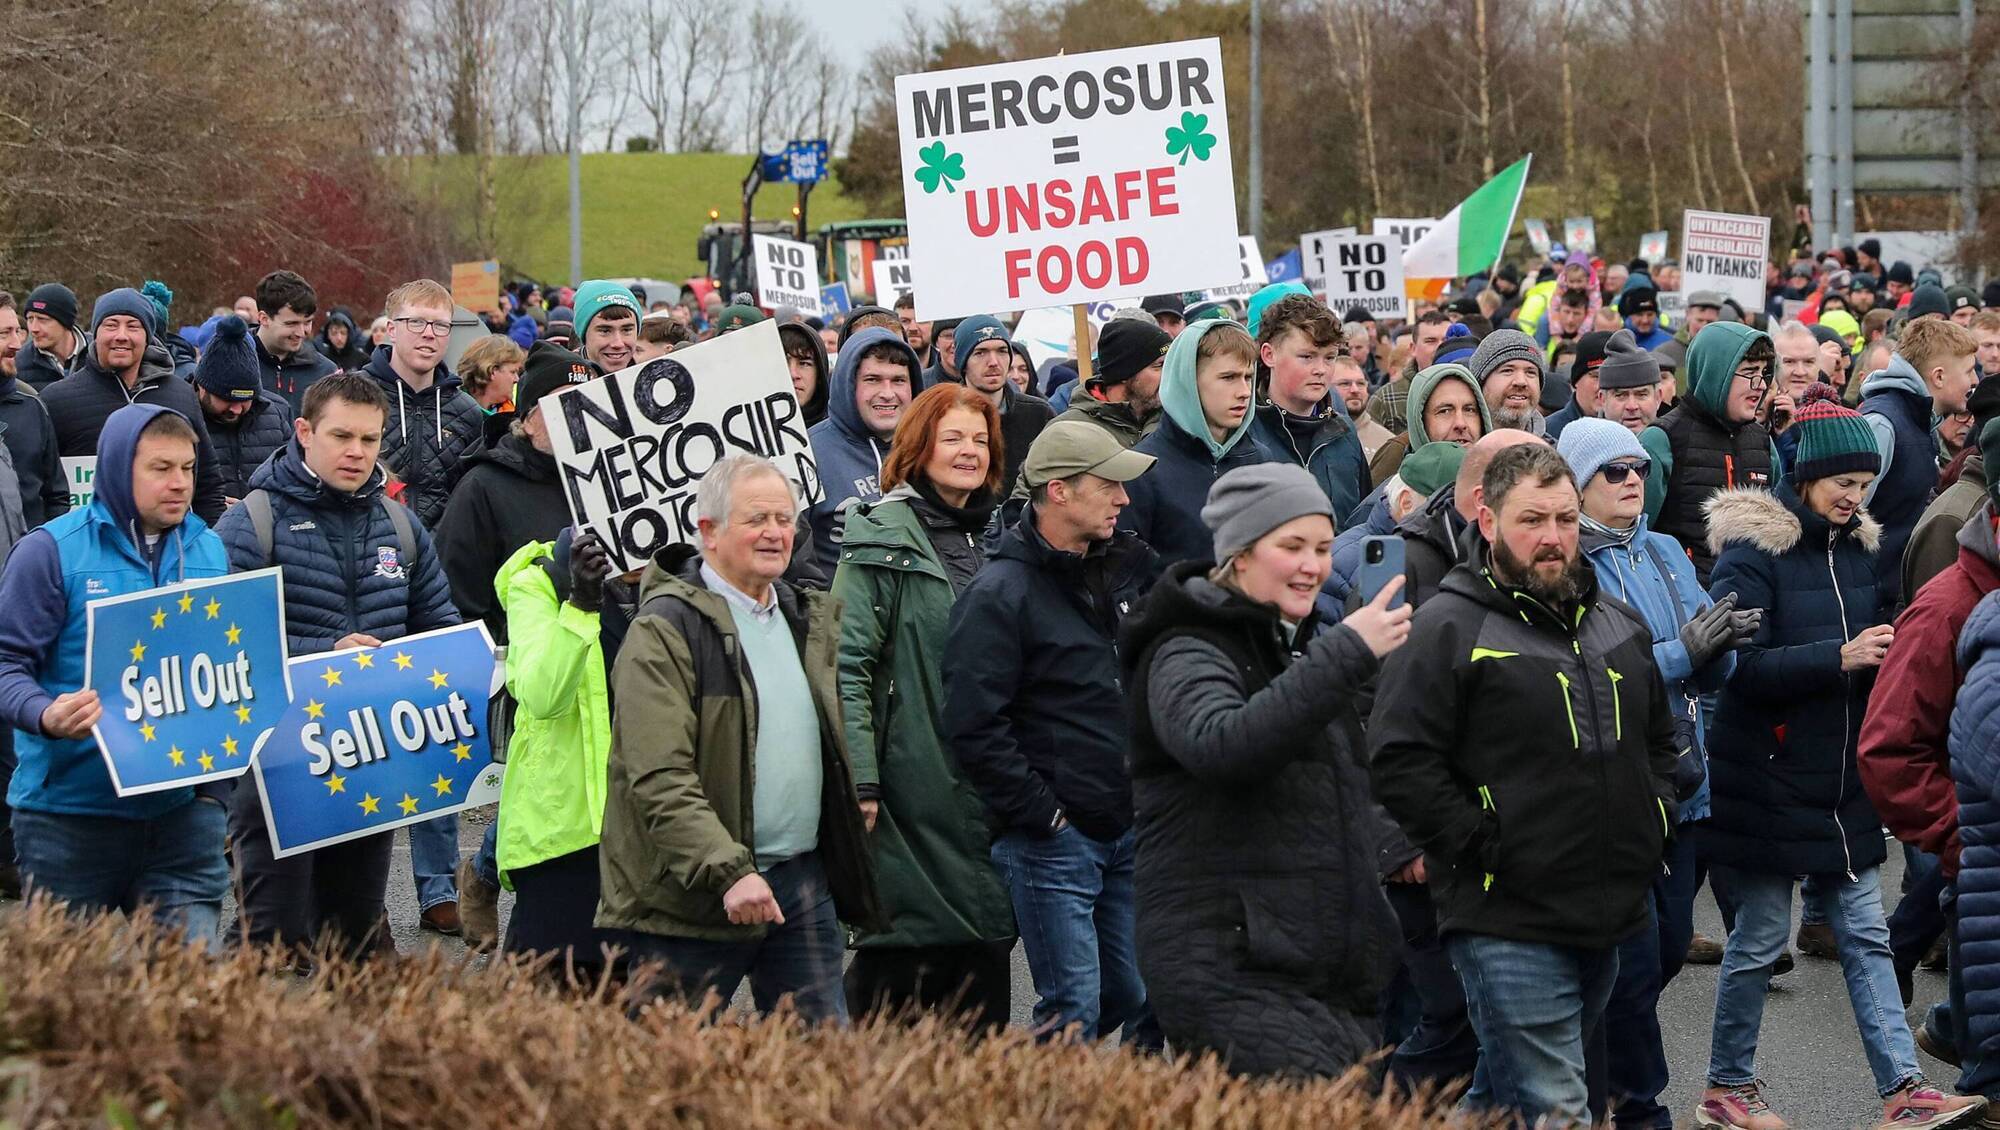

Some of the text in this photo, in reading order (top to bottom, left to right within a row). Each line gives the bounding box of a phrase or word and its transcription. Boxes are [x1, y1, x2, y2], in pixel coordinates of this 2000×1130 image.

[912, 57, 1215, 139] MERCOSUR
[965, 166, 1180, 238] UNSAFE
[1690, 217, 1764, 239] UNTRACEABLE
[767, 242, 805, 269] NO
[1339, 242, 1387, 266] NO
[1689, 235, 1763, 257] UNREGULATED
[771, 266, 805, 291] TO
[1005, 236, 1150, 299] FOOD
[1342, 269, 1386, 292] TO
[1686, 254, 1762, 280] NO THANKS!
[765, 289, 817, 311] MERCOSUR
[559, 359, 695, 455] NO
[562, 392, 808, 525] MERCOSUR
[120, 649, 255, 722] Sell Out
[300, 691, 476, 777] Sell Out
